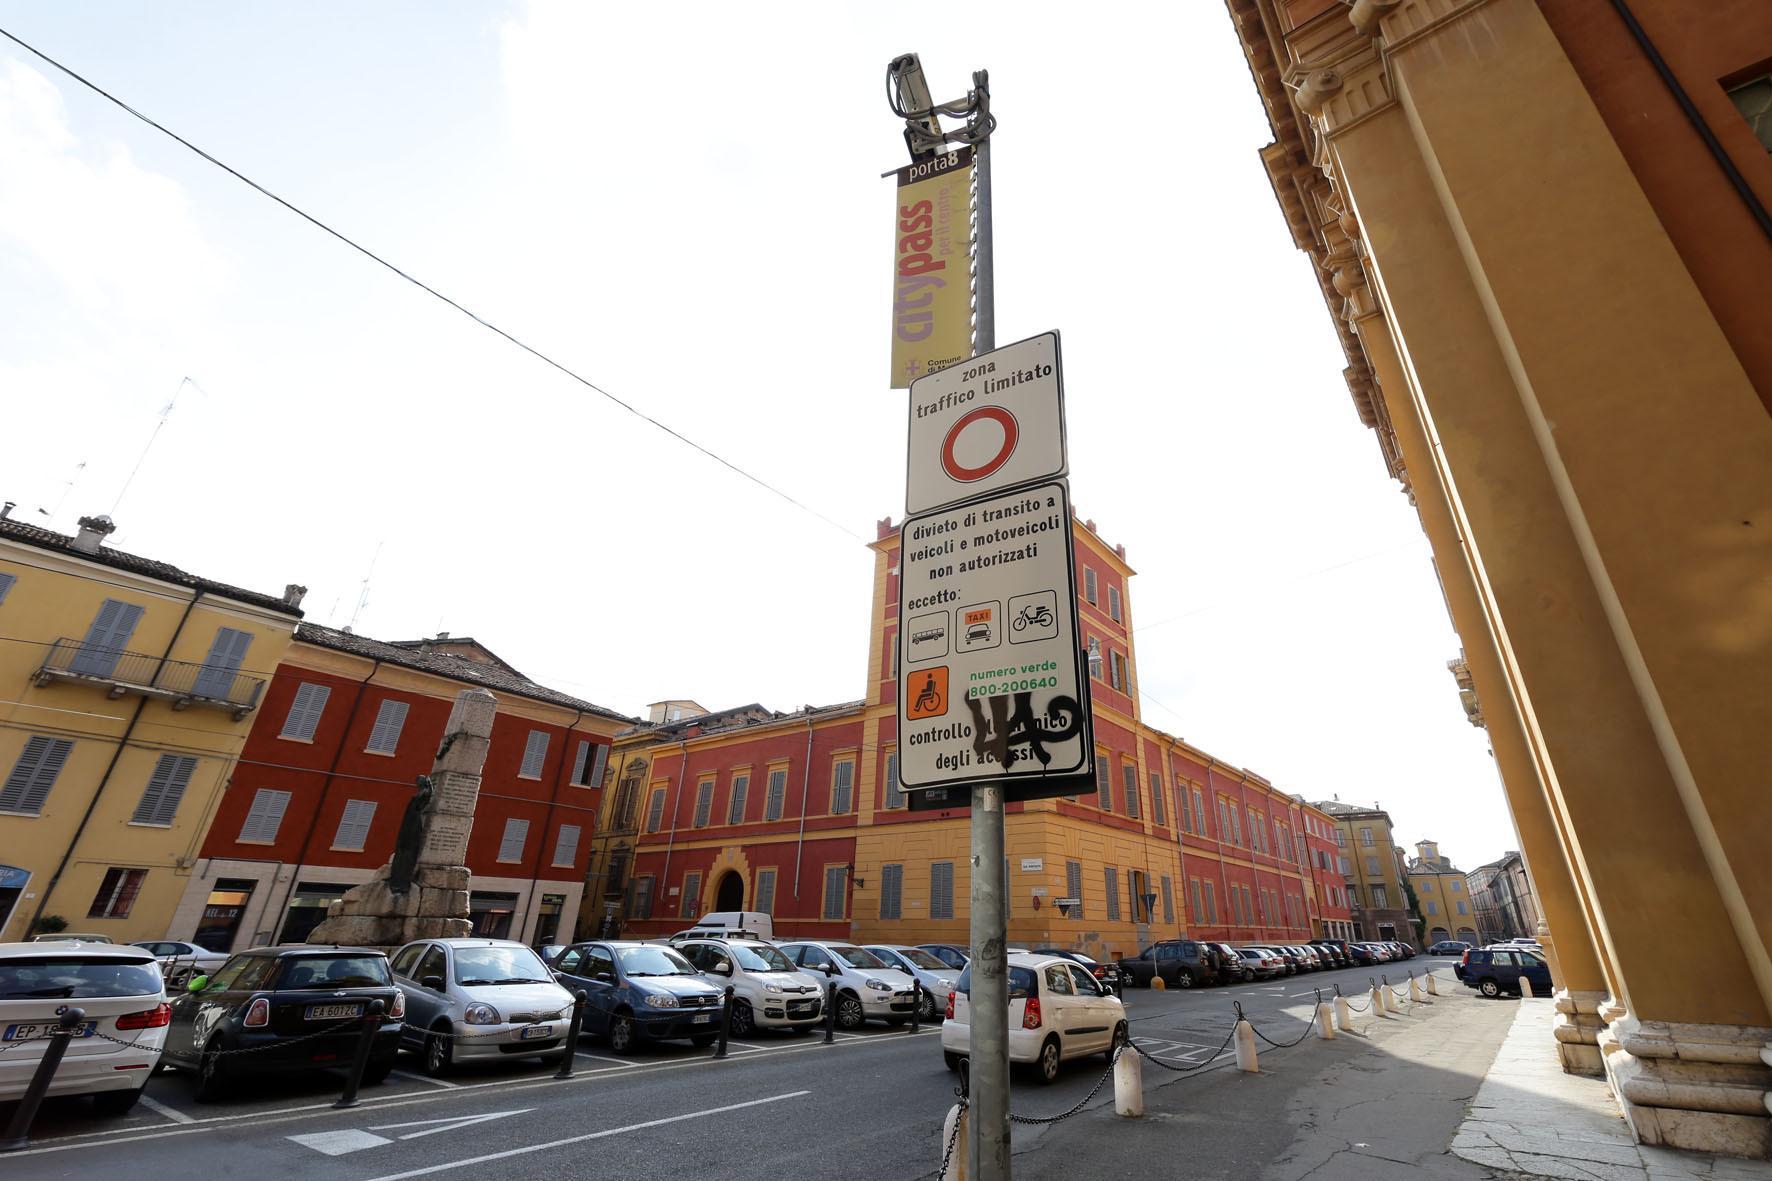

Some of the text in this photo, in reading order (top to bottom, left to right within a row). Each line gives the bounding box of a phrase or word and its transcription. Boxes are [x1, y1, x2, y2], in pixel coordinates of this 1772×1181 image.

[909, 151, 959, 182] porta8
[893, 200, 947, 342] citypass
[927, 355, 962, 366] Comune
[962, 360, 996, 382] zona
[917, 364, 1052, 418] traffico limitato
[912, 496, 1055, 540] divieto di transito a
[910, 514, 1060, 562] veicoli e motoveicoli
[929, 542, 1038, 580] non autorizzati
[908, 589, 960, 610] eccetto:
[967, 611, 989, 622] TAXI
[970, 659, 1057, 681] numero verde
[970, 676, 1057, 697] 800-200640
[909, 723, 971, 745] controllo
[936, 745, 1033, 771] degli acssi
